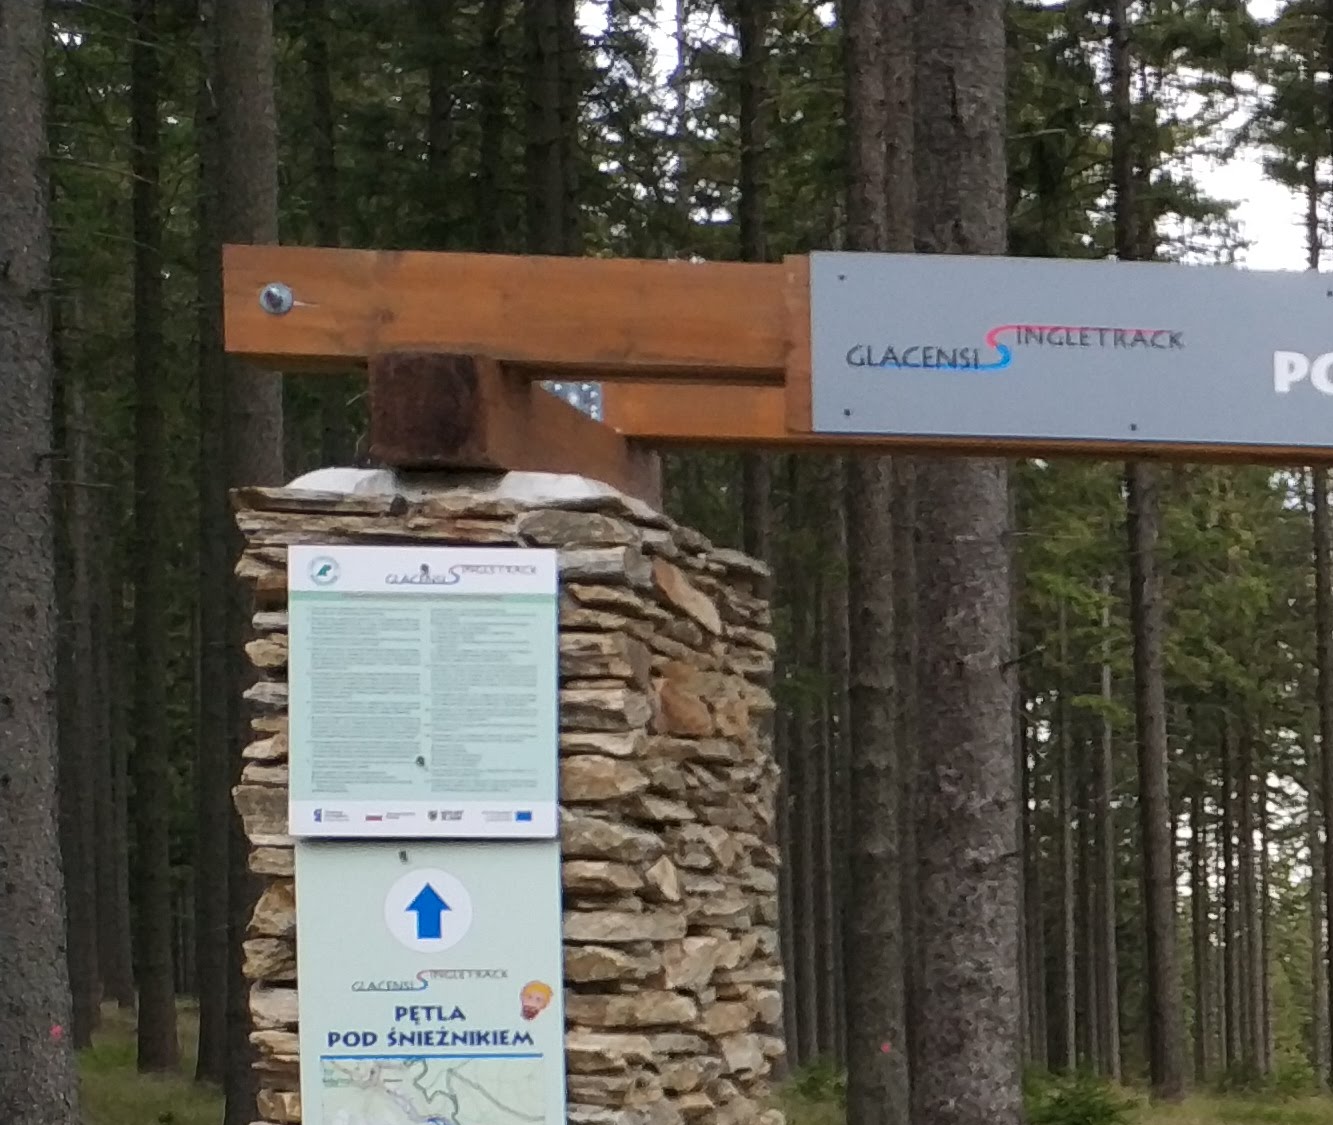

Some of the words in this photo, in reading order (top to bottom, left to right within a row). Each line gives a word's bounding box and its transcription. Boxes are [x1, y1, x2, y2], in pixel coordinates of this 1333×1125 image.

[395, 1005, 467, 1025] PĘTLA
[327, 1031, 377, 1047] POD
[387, 1026, 535, 1047] ŚNIEŻNIKIEM
